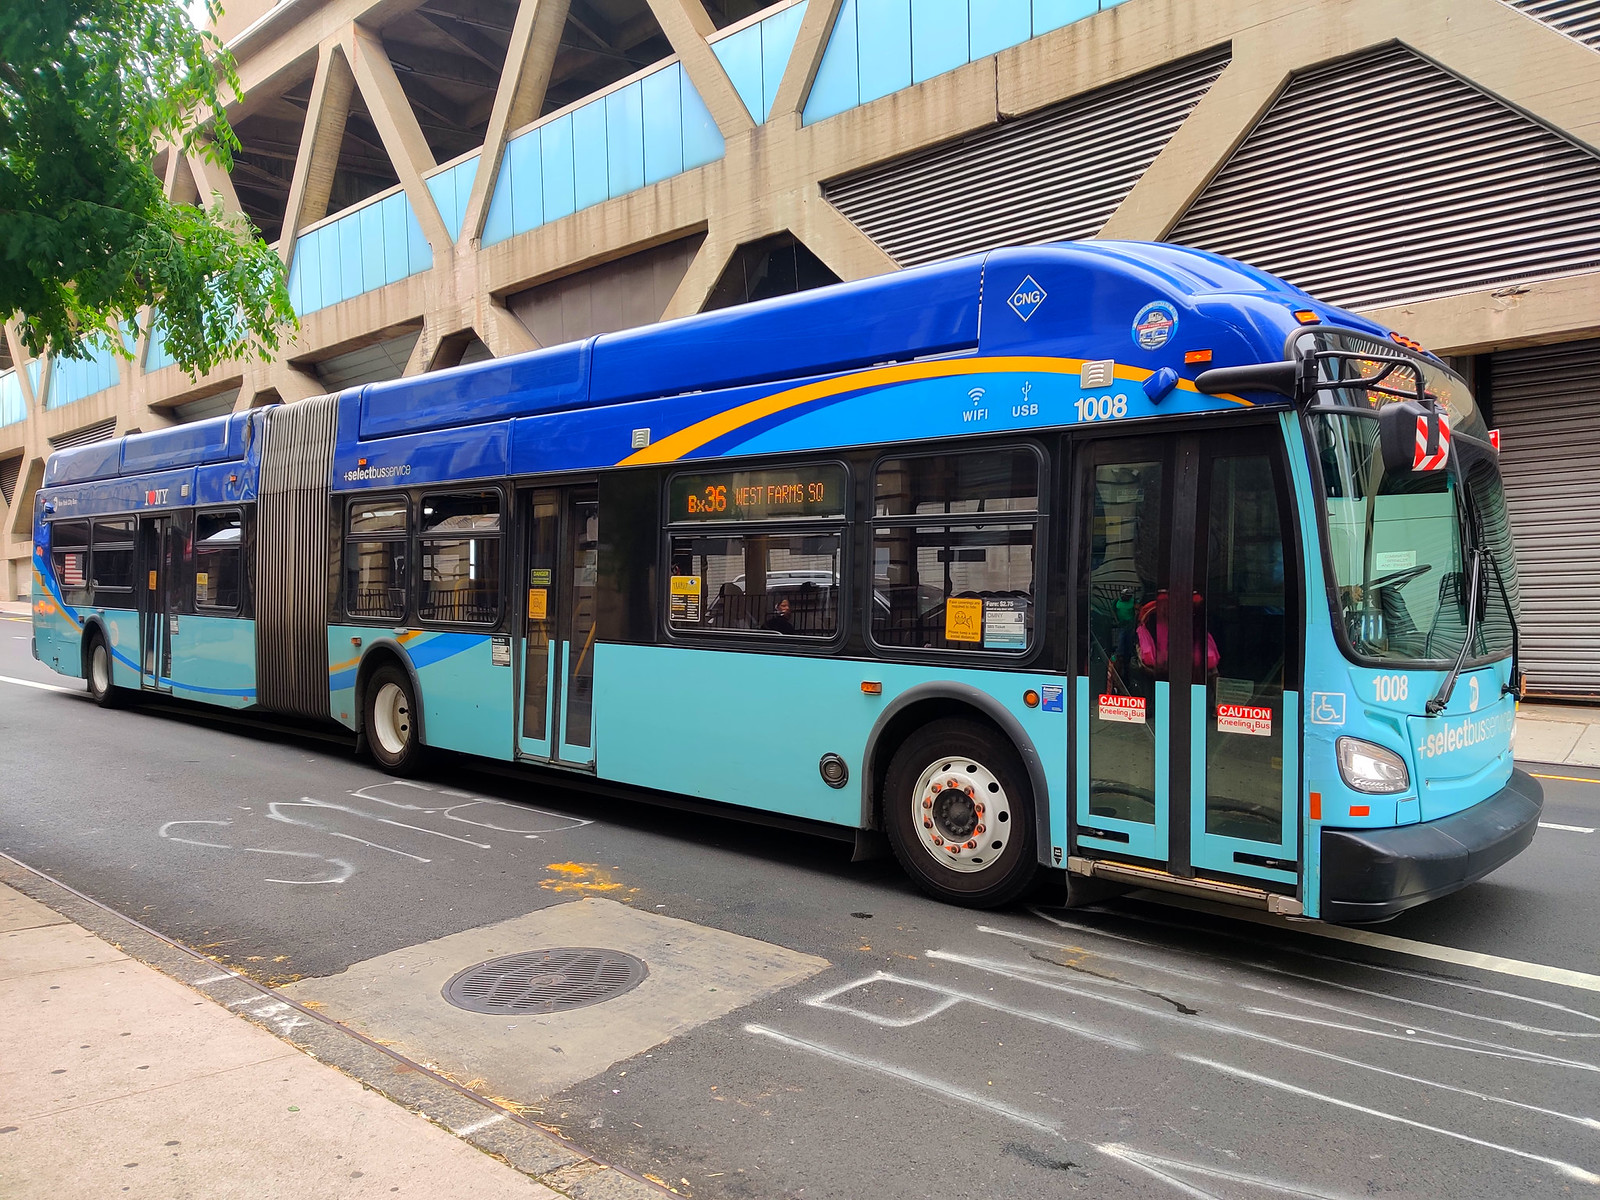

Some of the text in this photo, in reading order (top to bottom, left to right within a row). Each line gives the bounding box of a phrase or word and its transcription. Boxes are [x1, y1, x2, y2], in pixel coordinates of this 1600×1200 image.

[1013, 290, 1041, 306] CNG
[1012, 403, 1039, 417] USB
[1073, 393, 1128, 422] 1008
[962, 408, 988, 422] WIFI
[688, 482, 824, 513] Bx36 WEST FARMS SQ
[1372, 675, 1408, 701] 1008
[1100, 696, 1145, 708] CAUTION
[1100, 707, 1145, 717] Kneeling Bus
[1219, 706, 1270, 719] CAUTION
[1219, 718, 1270, 729] Kneeling Bus
